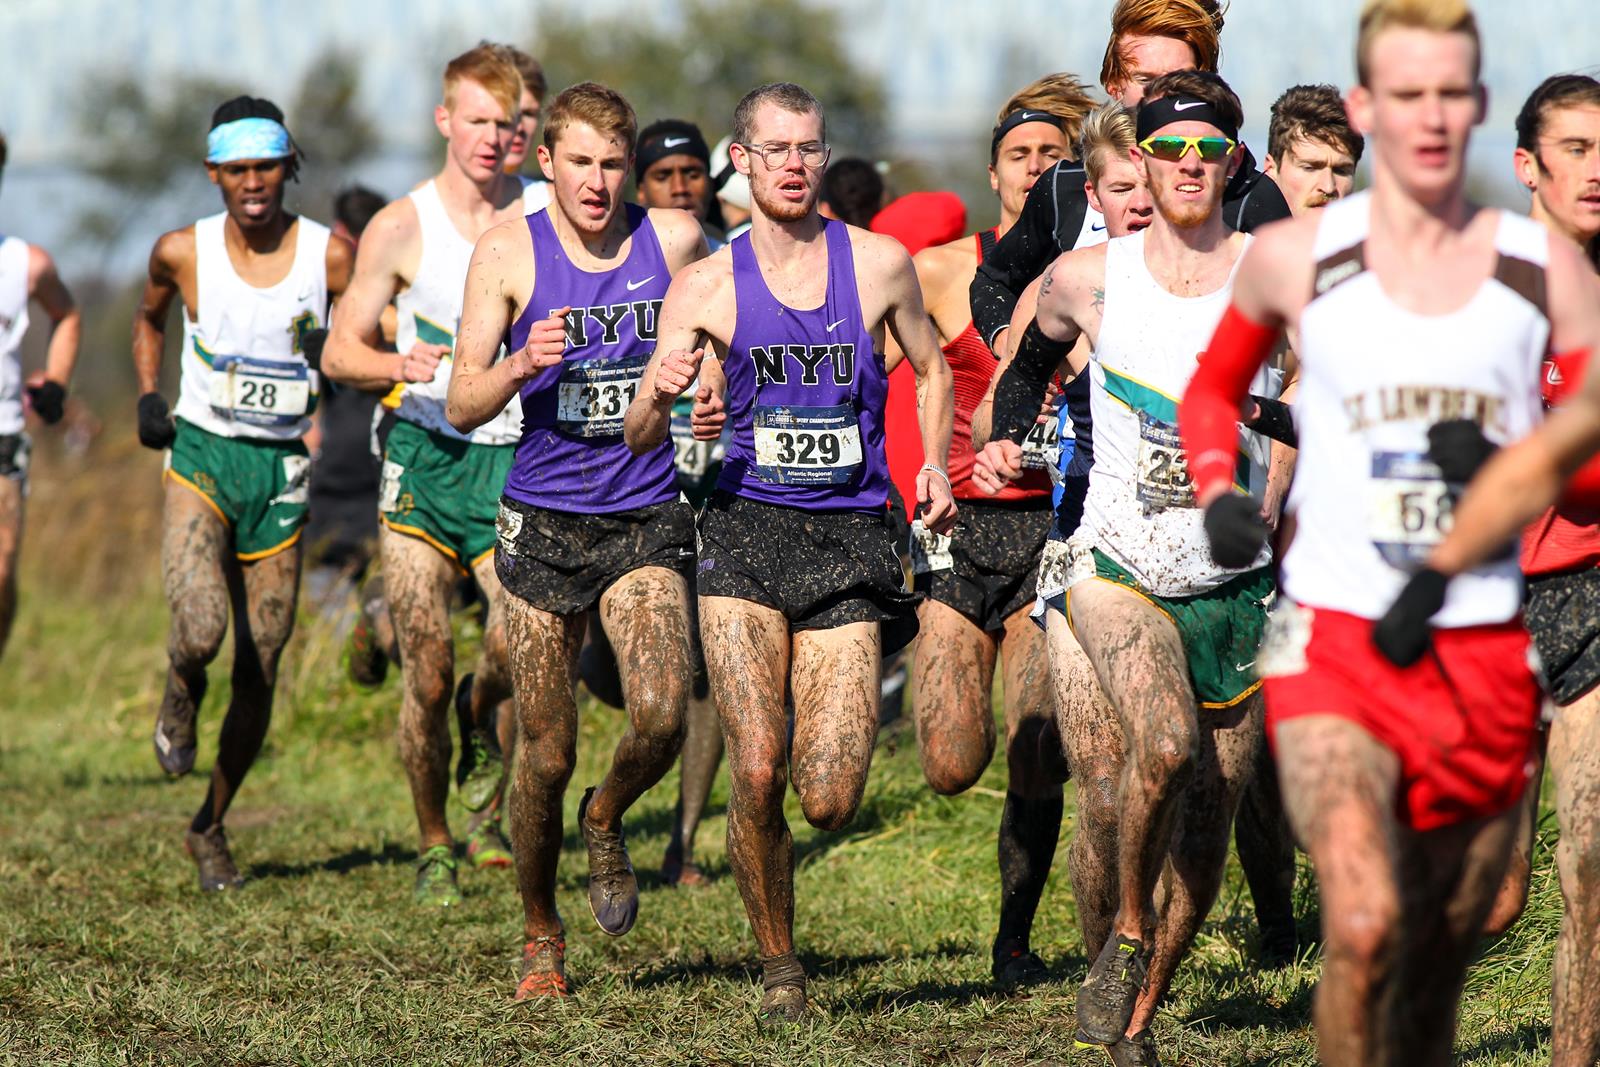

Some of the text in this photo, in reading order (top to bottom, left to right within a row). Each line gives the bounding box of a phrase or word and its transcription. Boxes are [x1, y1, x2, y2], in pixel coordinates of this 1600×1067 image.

[549, 299, 664, 349] NYU
[750, 344, 854, 386] NYU
[240, 381, 277, 408] 28
[580, 383, 636, 418] 331
[776, 432, 840, 465] 329
[807, 470, 833, 478] Regional
